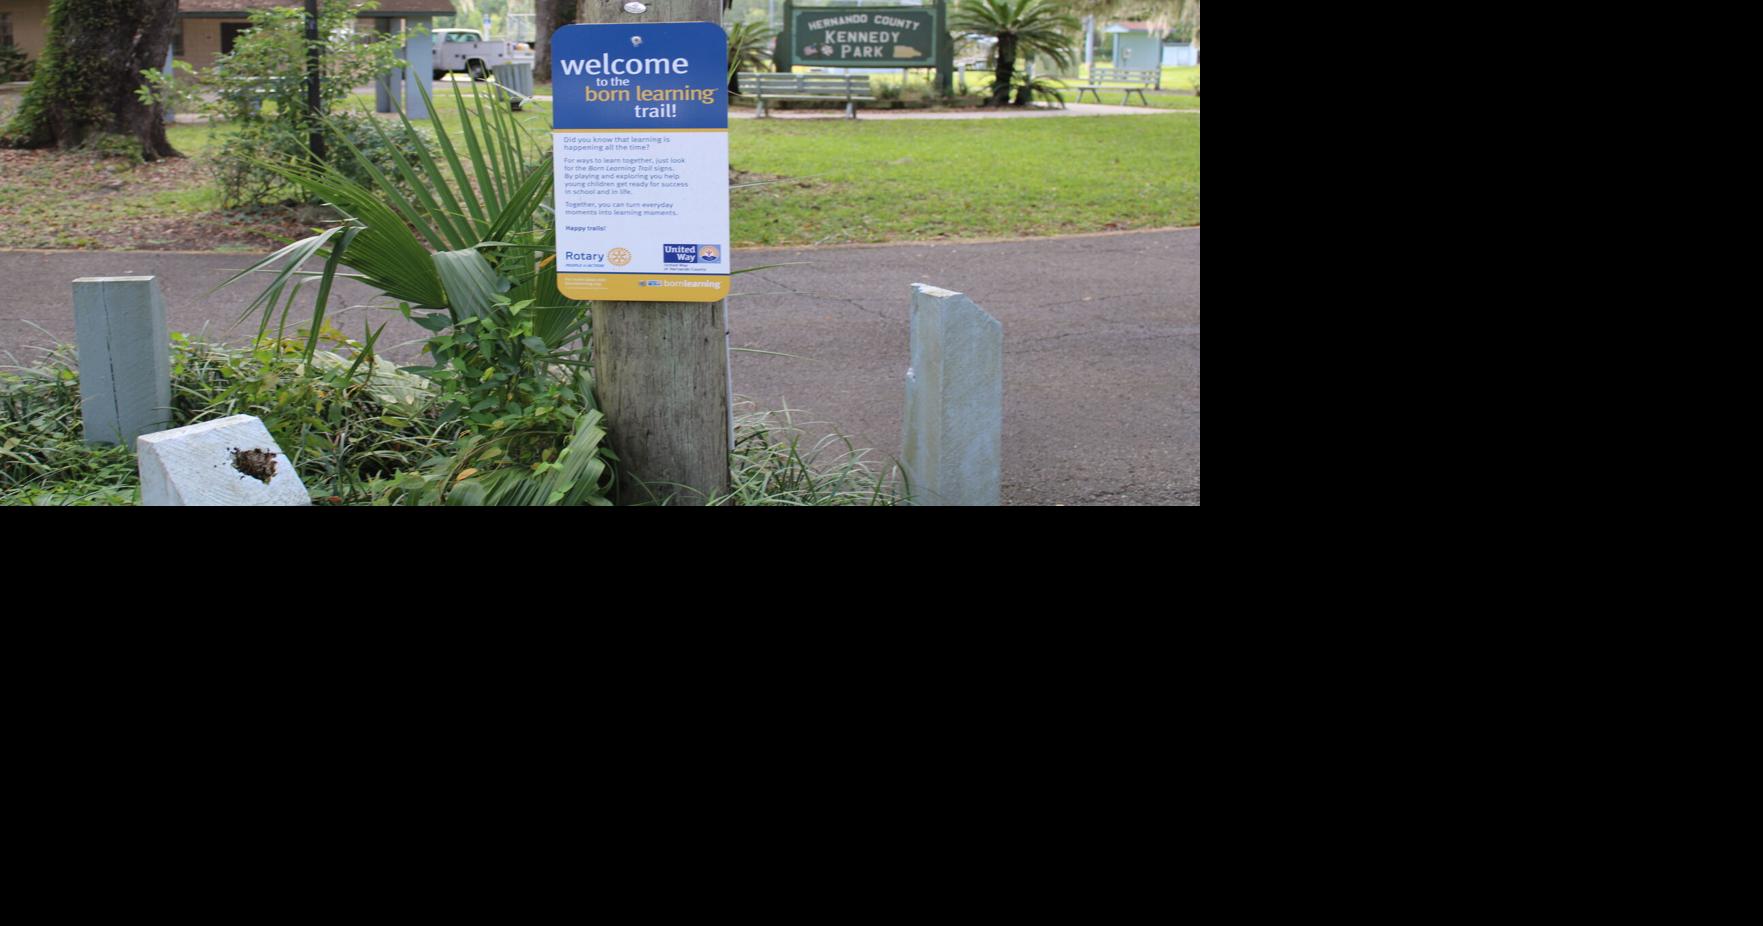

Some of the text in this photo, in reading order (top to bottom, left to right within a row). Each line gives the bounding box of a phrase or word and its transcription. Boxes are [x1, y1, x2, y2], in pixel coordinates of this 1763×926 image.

[808, 14, 920, 30] HERNANDO COUNTY
[825, 30, 900, 43] KENNEDY
[841, 45, 883, 58] PARK
[560, 53, 689, 75] welcome
[596, 77, 630, 86] to the
[585, 85, 714, 104] born learning
[634, 104, 677, 118] trail!
[565, 252, 604, 262] Rotary
[677, 254, 695, 262] Way
